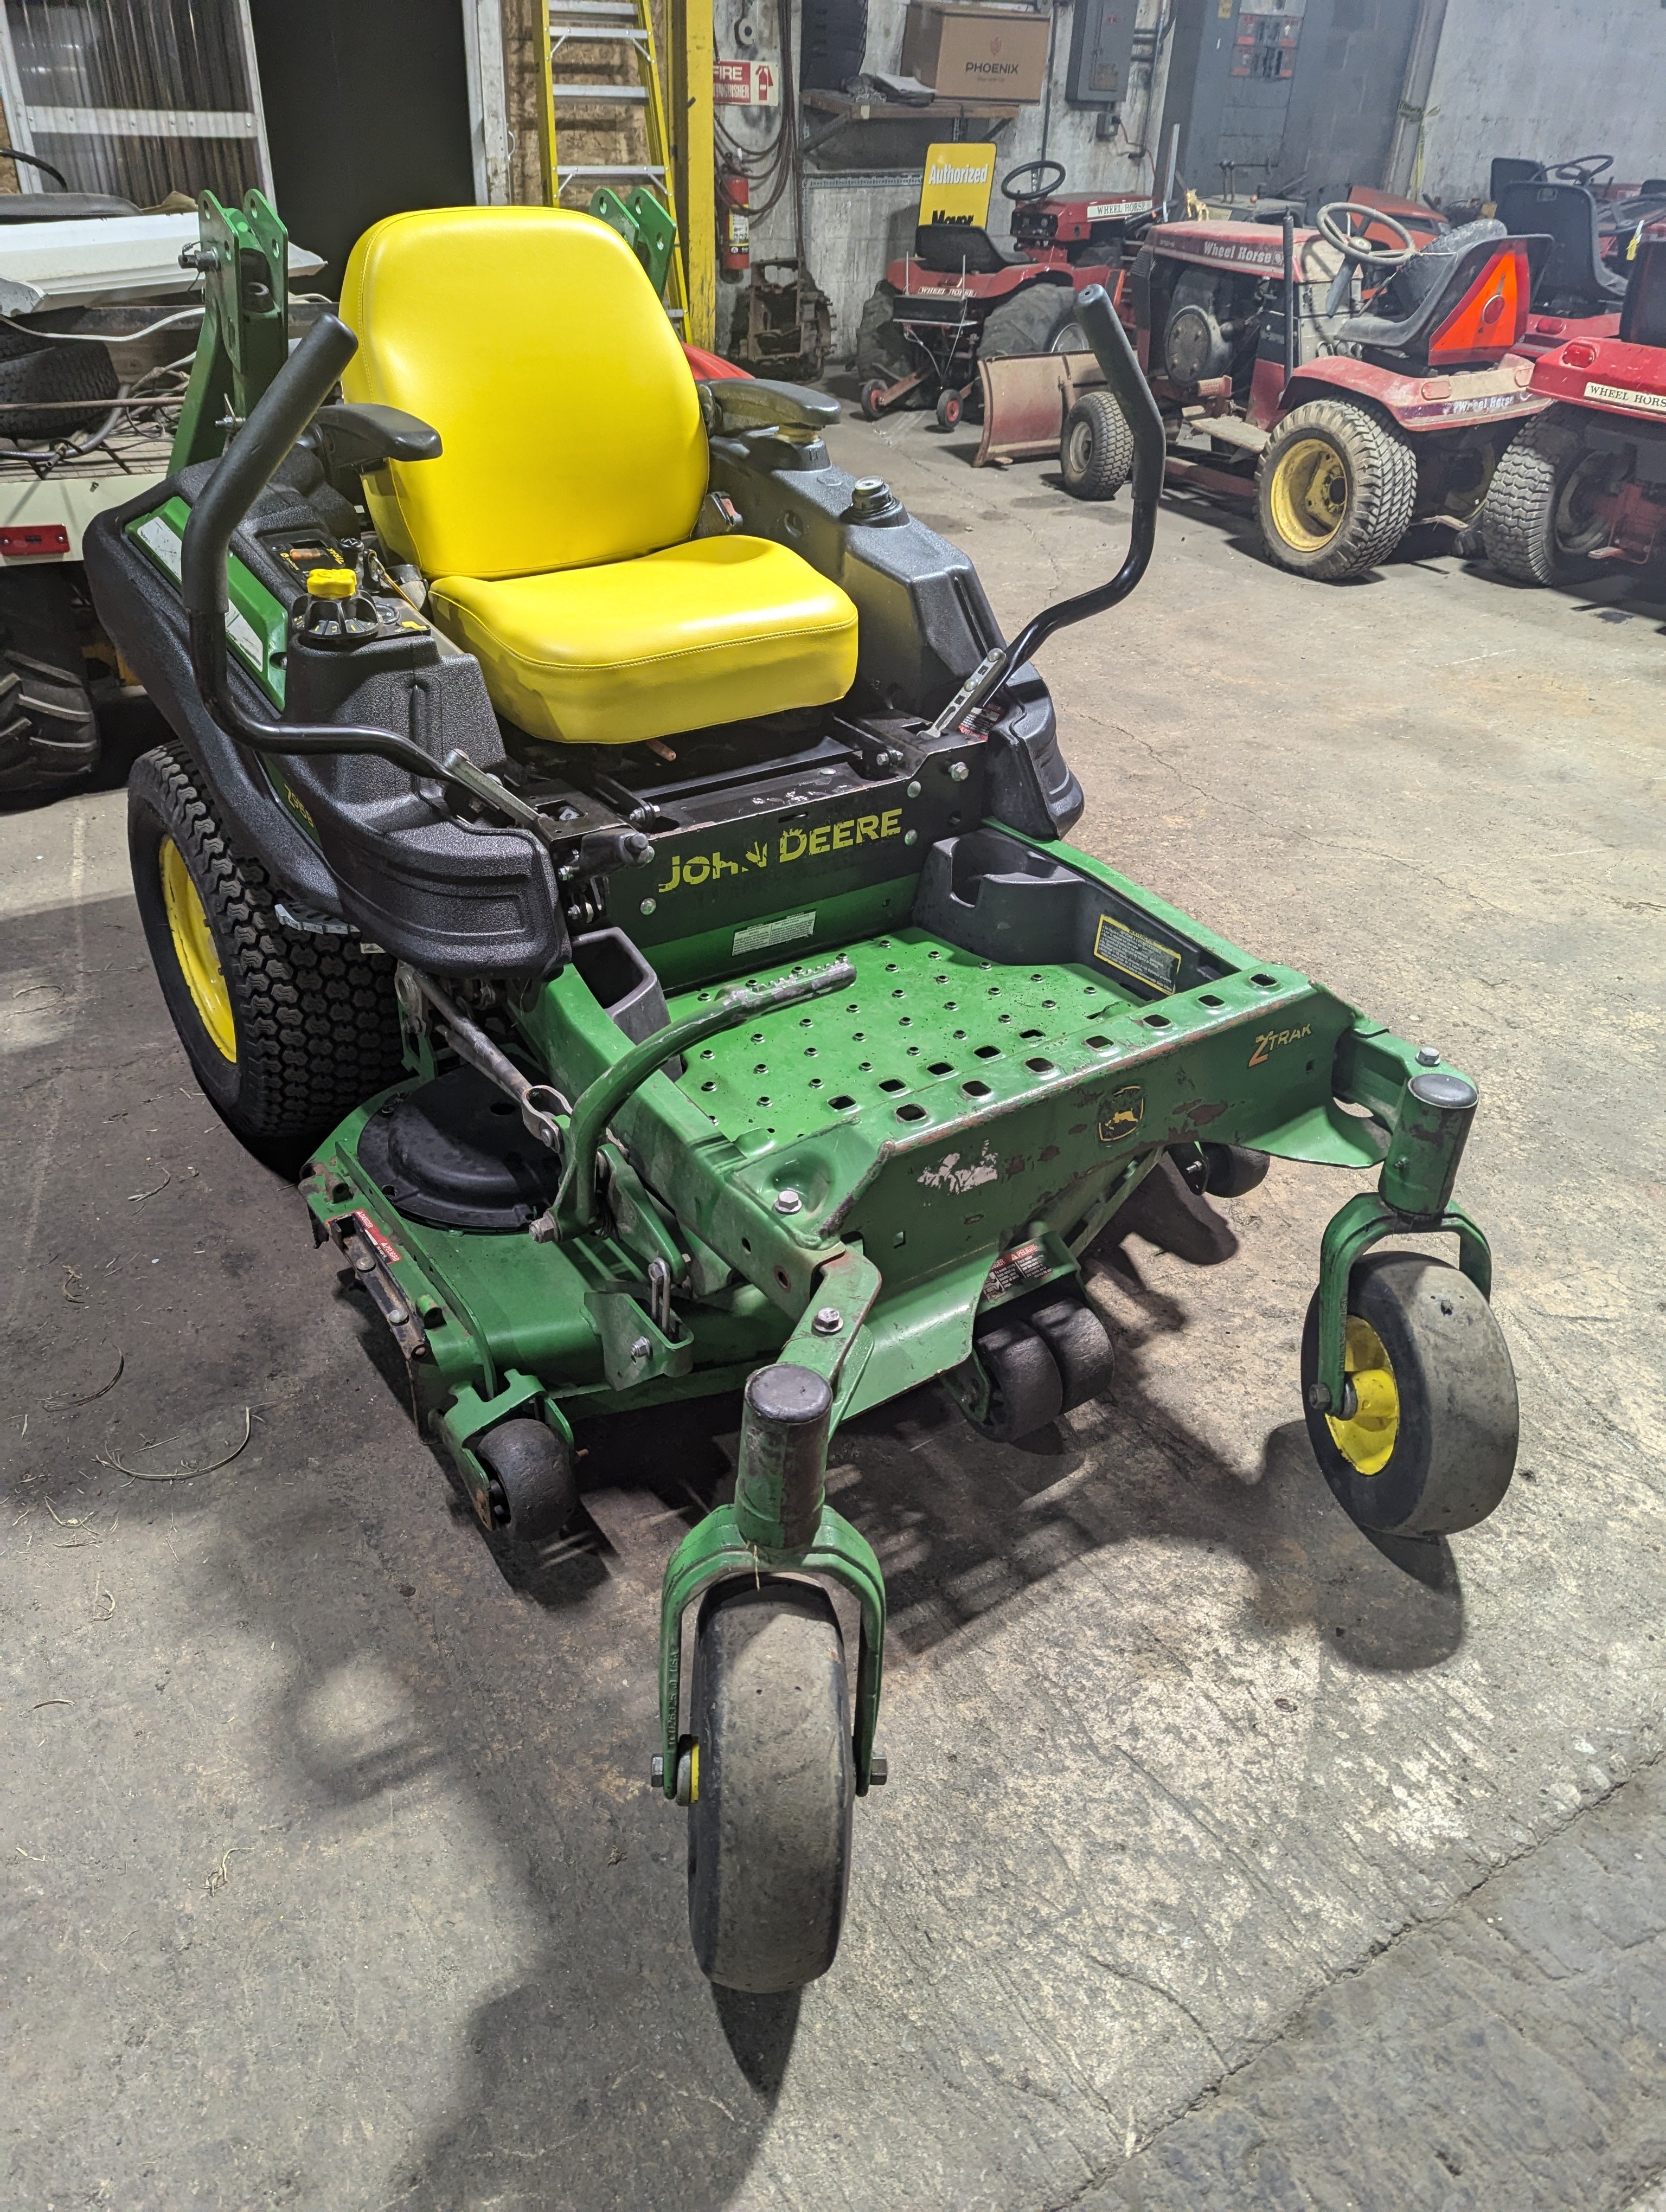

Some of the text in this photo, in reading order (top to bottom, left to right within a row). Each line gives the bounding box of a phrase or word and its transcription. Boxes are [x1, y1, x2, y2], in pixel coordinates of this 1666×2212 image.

[713, 66, 742, 81] FIRE
[965, 61, 1018, 74] PHOENIX
[928, 164, 989, 185] Authorized
[1097, 202, 1146, 215] WHEEL HORSE
[1204, 241, 1272, 263] Wheel Horse
[1590, 385, 1666, 408] WHEEL HORS
[779, 808, 902, 863] DEERE
[1248, 1023, 1312, 1068] ZTRAK
[669, 1651, 679, 1673] USA
